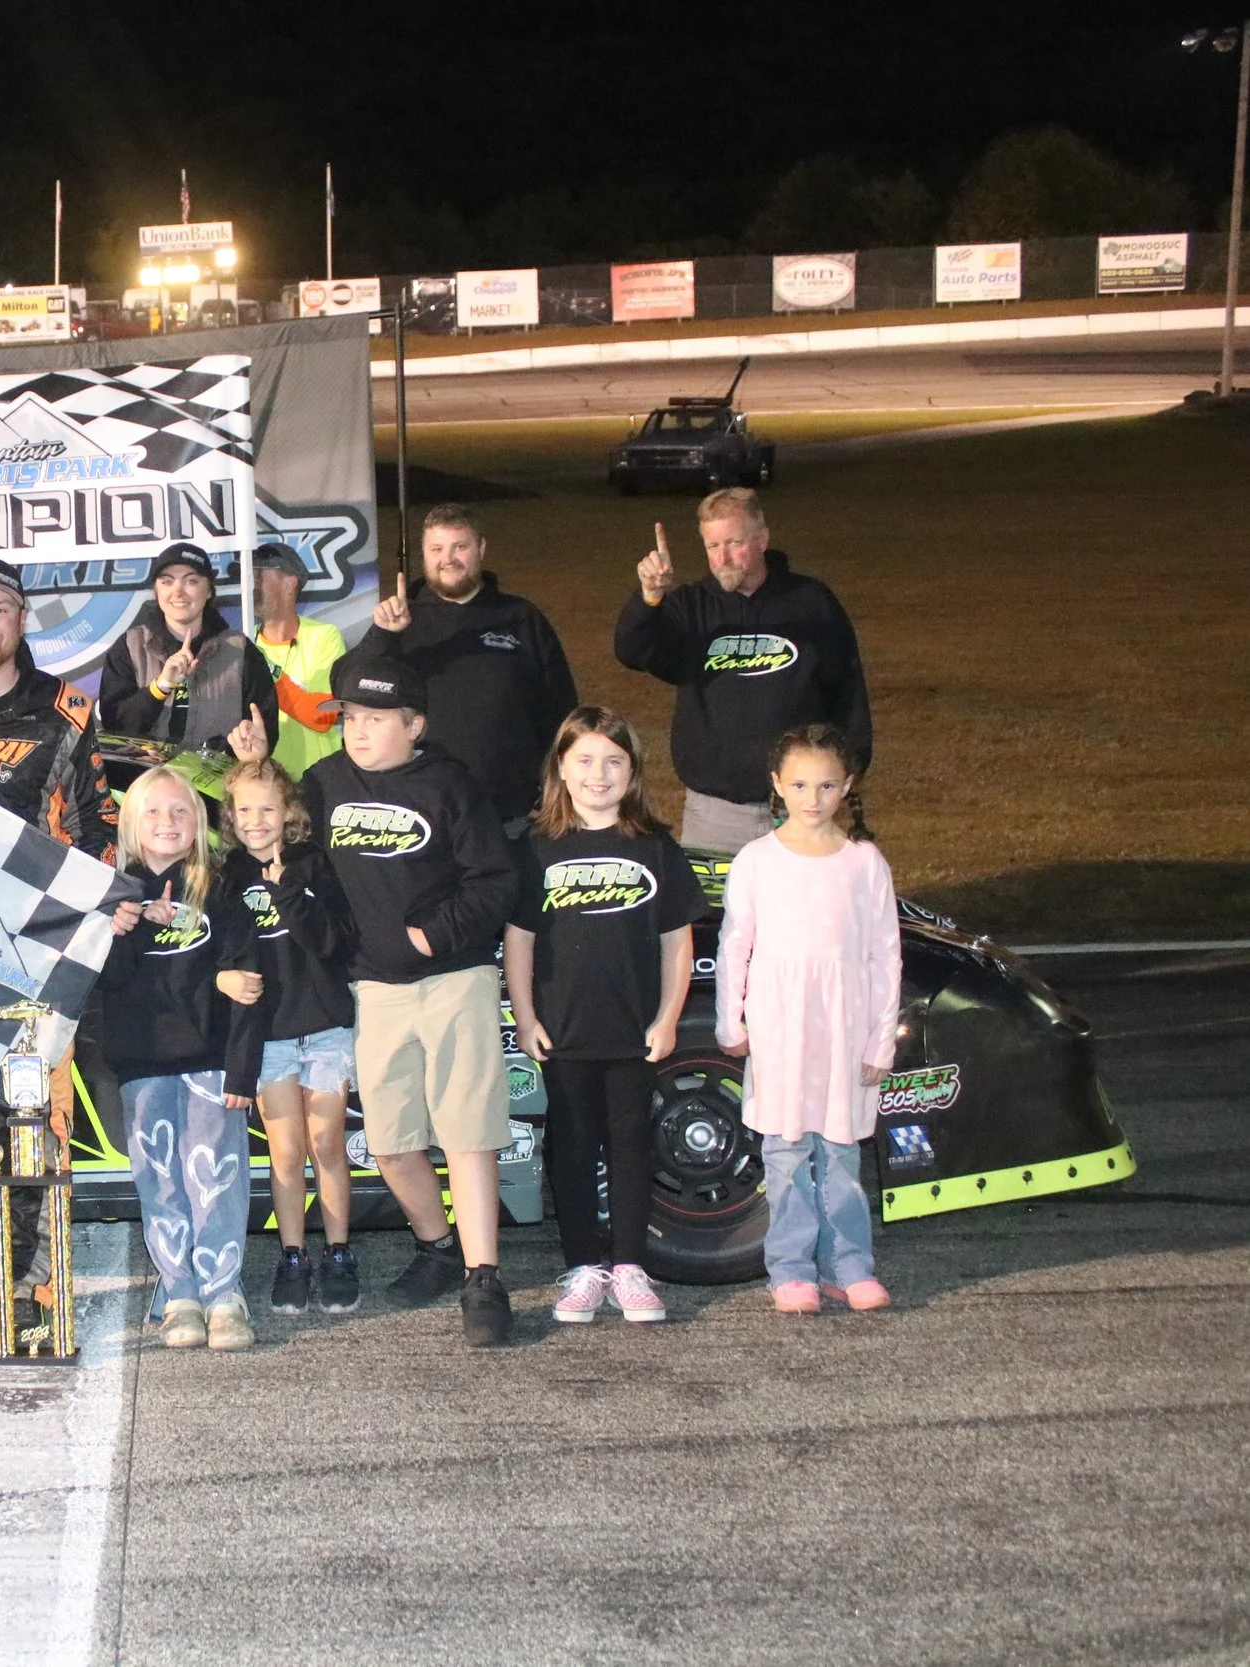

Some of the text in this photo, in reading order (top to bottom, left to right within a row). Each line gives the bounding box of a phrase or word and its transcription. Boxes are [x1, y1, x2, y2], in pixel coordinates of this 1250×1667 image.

[142, 225, 229, 244] UnionBank
[1116, 252, 1161, 262] ASPHALT
[941, 272, 1017, 284] Auto Parts
[2, 302, 38, 312] Milton
[470, 304, 511, 317] MARKET
[43, 453, 137, 482] PARK
[35, 619, 94, 657] MOUNTAINS
[704, 654, 791, 672] Racing
[330, 806, 419, 832] GRAY
[330, 826, 423, 851] Racing
[543, 863, 646, 890] GRAY
[542, 884, 648, 913] Racing
[880, 1069, 955, 1092] SWEET
[500, 1151, 529, 1161] SWEET
